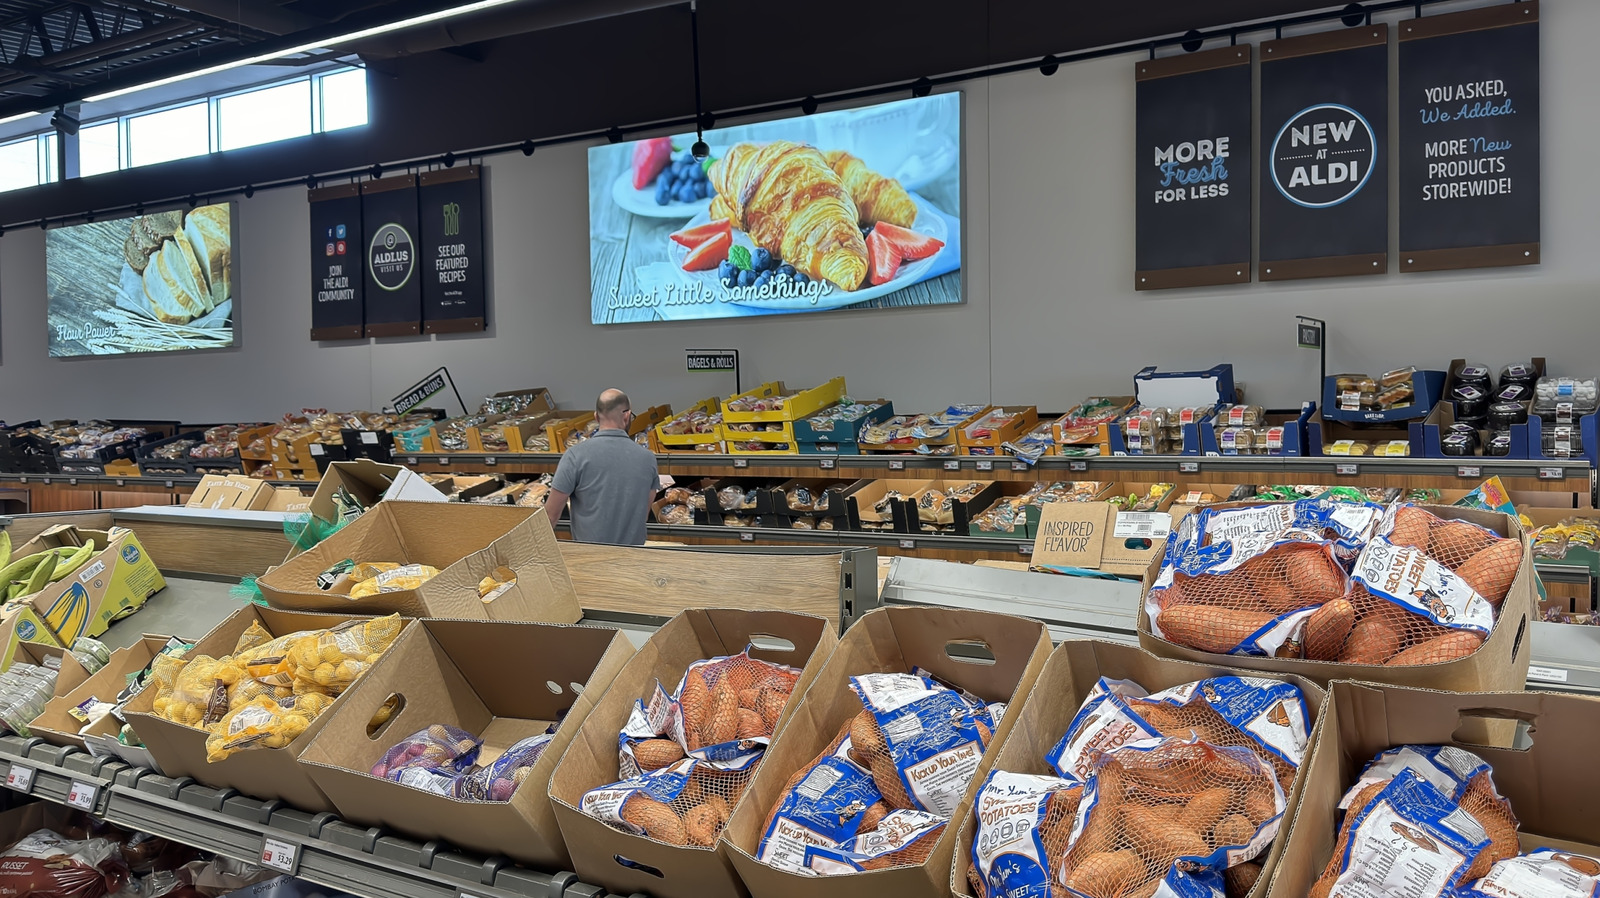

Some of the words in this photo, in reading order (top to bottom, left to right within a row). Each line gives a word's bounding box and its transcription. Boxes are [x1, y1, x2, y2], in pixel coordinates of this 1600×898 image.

[1425, 86, 1453, 104] YOU
[1455, 79, 1508, 100] ASKED,
[1420, 108, 1450, 125] We
[1453, 100, 1517, 121] Added.
[1291, 120, 1357, 147] NEW
[1154, 136, 1230, 167] MORE
[1315, 148, 1328, 161] AT
[1425, 139, 1468, 158] MORE
[1469, 137, 1512, 153] New
[1159, 155, 1229, 187] Fresh
[1288, 160, 1359, 188] ALDI
[1428, 156, 1506, 179] PRODUCTS
[1154, 186, 1187, 203] FOR
[1190, 182, 1230, 200] LESS
[1422, 178, 1512, 201] STOREWIDE!
[374, 250, 409, 265] ALDI.US
[438, 245, 451, 258] SEE
[450, 243, 466, 256] OUR
[328, 265, 342, 278] JOIN
[380, 265, 396, 273] VISIT
[396, 264, 404, 272] US
[435, 256, 469, 271] FEATURED
[323, 278, 335, 290] THE
[334, 277, 349, 289] ALDI
[438, 270, 466, 284] RECIPES
[318, 288, 355, 303] COMMUNITY
[608, 286, 661, 310] Sweet
[664, 282, 715, 307] Little
[718, 273, 833, 305] Somethings
[56, 324, 84, 341] Flour
[84, 322, 116, 339] Power
[688, 357, 710, 369] BAGELS
[710, 357, 716, 368] &
[716, 357, 734, 368] ROLLS
[395, 393, 420, 414] BREAD
[418, 390, 426, 400] &
[423, 377, 443, 396] BUNS
[1043, 521, 1094, 537] INSPIRED
[1384, 548, 1410, 594] OTATOES
[910, 769, 930, 782] KICK
[927, 764, 938, 774] UP
[936, 756, 957, 769] YOUR
[985, 784, 1004, 796] Mr.
[981, 802, 1037, 826] POTATOES
[1, 861, 30, 870] RUSSET
[277, 854, 293, 866] $3.29
[252, 881, 279, 895] BOMBAY
